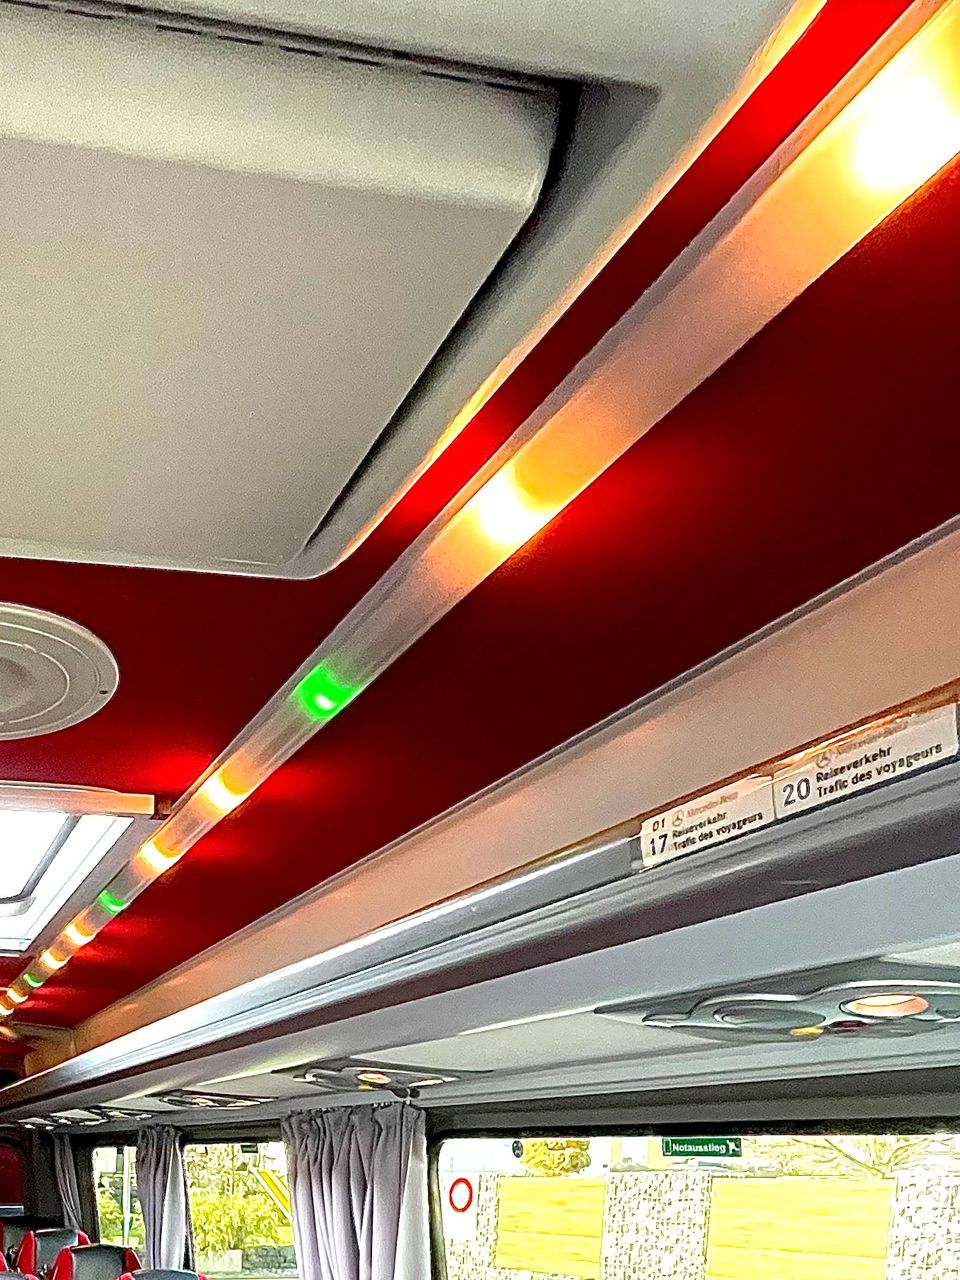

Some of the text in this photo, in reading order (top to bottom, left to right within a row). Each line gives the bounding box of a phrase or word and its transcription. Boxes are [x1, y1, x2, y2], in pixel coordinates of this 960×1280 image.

[816, 747, 892, 783] Reiseverkehr
[817, 743, 943, 798] Trafic des voyageurs
[782, 777, 811, 807] 20
[698, 830, 714, 841] des
[716, 812, 763, 836] voyageurs
[650, 833, 668, 856] 17
[672, 1143, 727, 1154] Notausstieg
